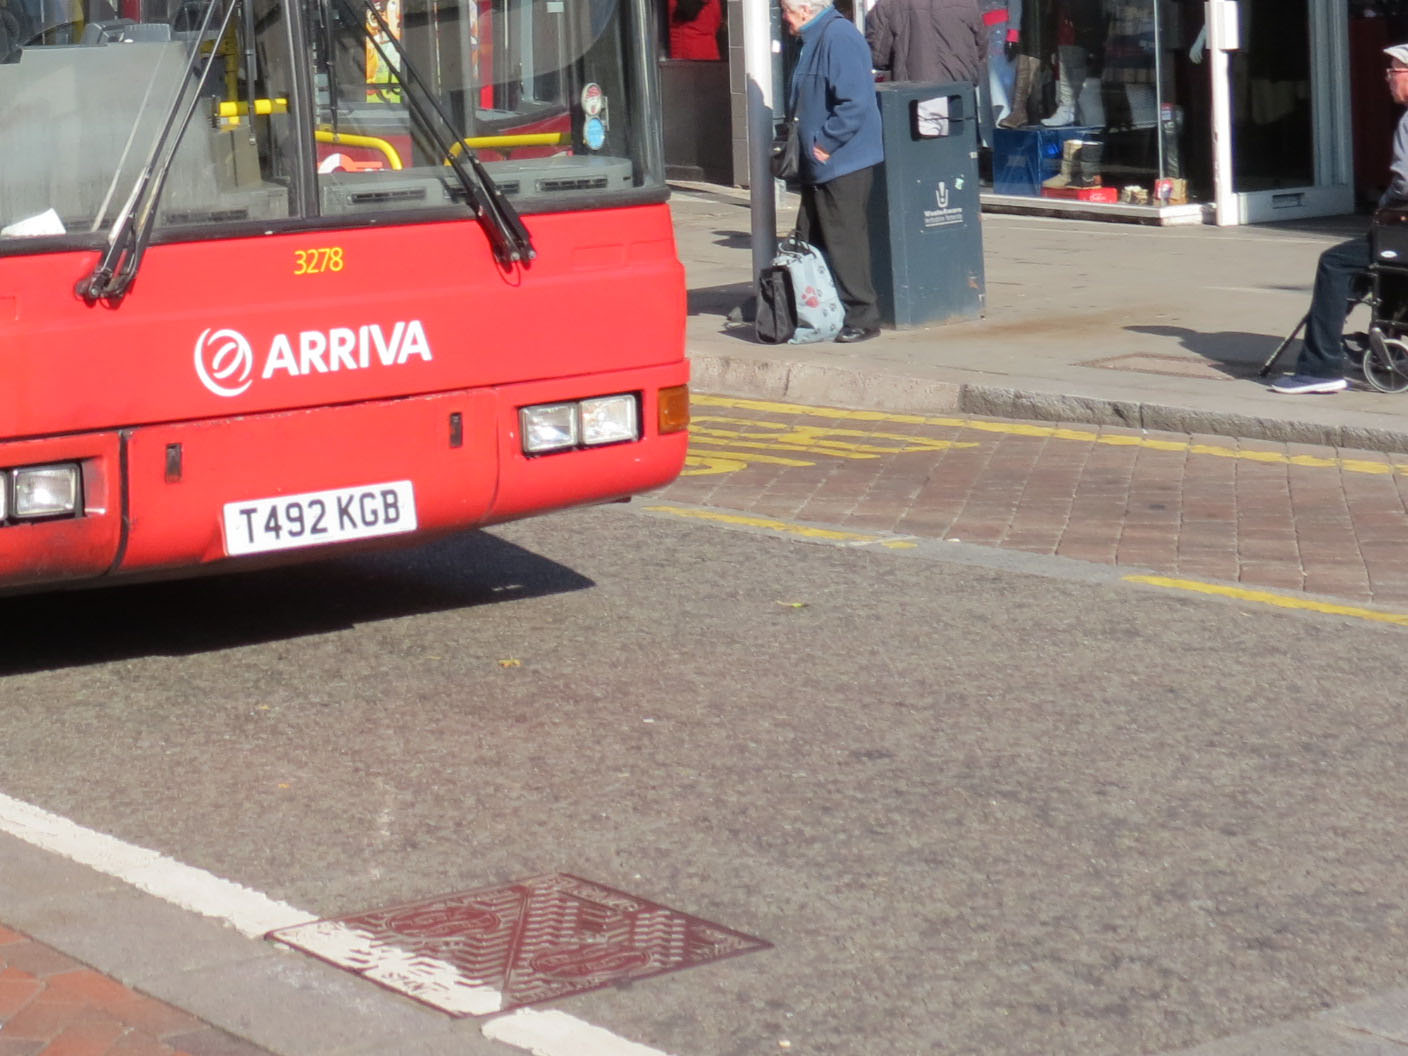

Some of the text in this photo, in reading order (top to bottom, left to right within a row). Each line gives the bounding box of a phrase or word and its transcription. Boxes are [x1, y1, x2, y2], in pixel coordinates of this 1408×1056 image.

[294, 247, 344, 275] 3278
[261, 320, 433, 379] ARRIVA
[239, 489, 400, 544] T492 KGB
